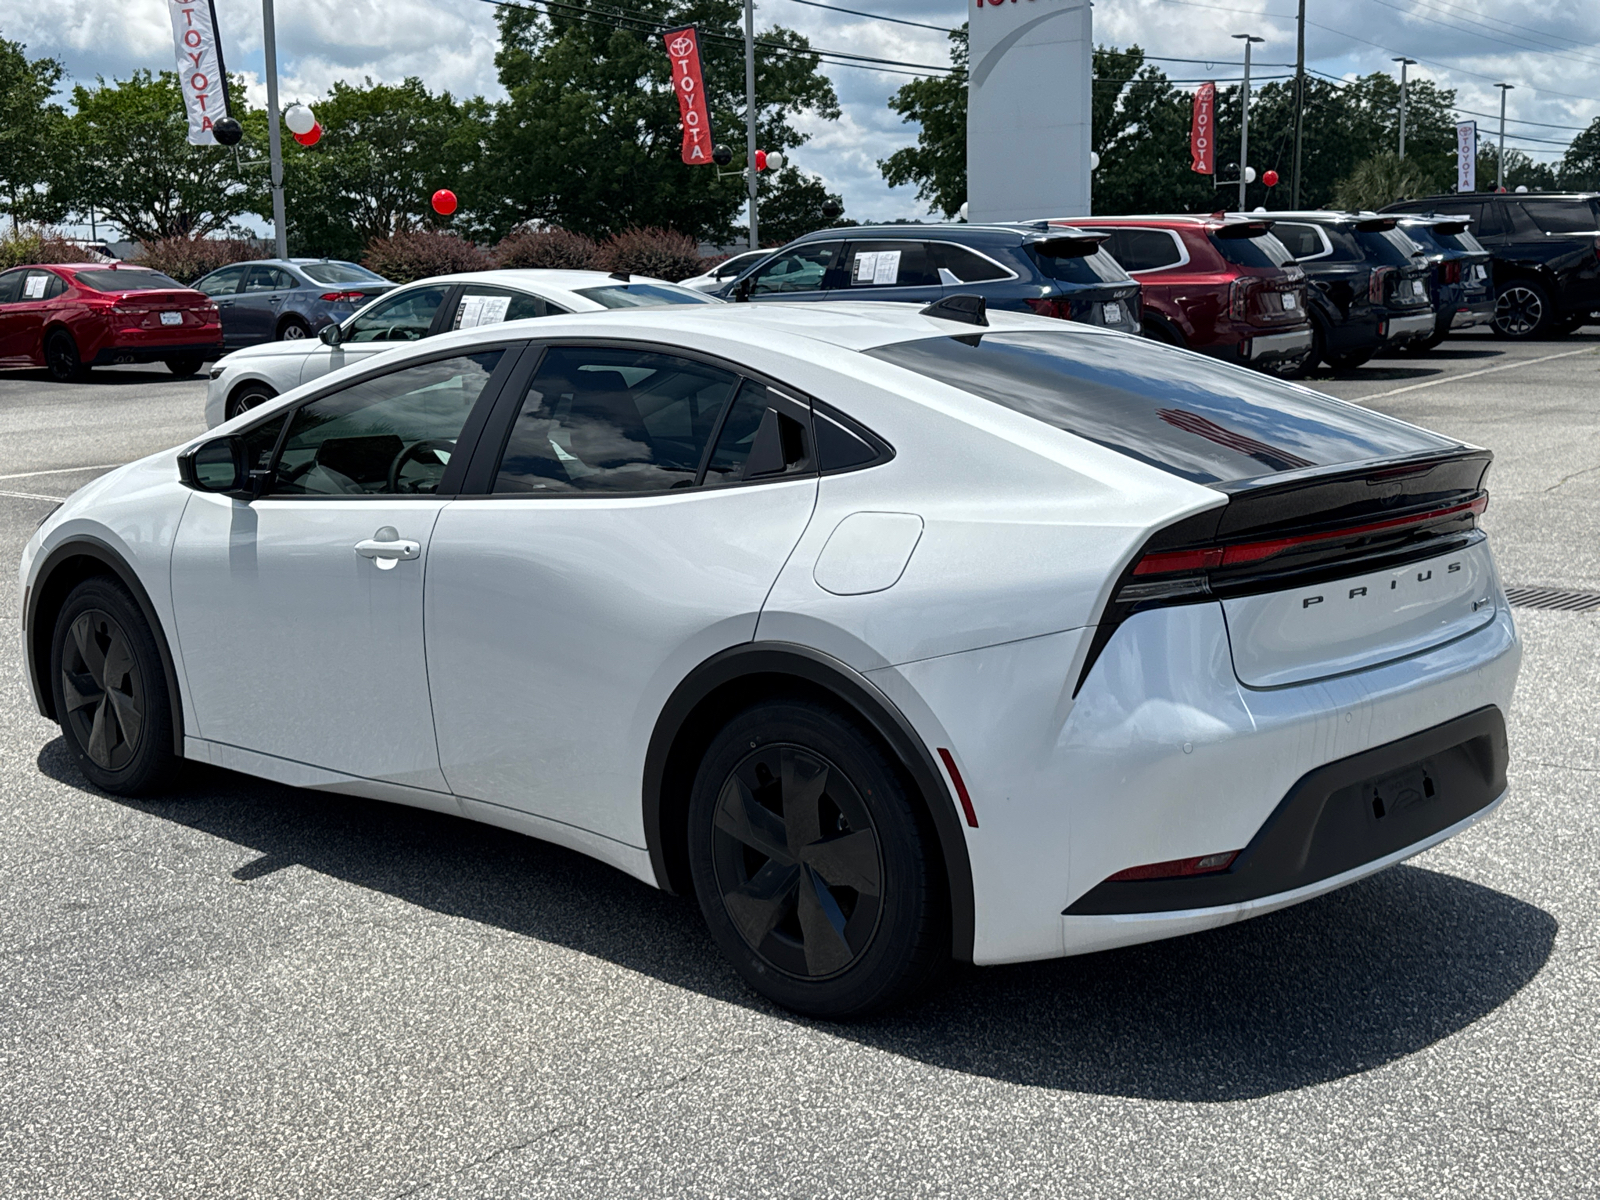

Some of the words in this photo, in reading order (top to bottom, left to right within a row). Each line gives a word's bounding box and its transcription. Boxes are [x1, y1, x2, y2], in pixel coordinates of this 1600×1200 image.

[182, 8, 213, 133] TOYOTA
[678, 59, 705, 160] TOYOTA
[1196, 102, 1208, 171] TOYOTA
[1461, 136, 1470, 188] TOYOTA
[1302, 561, 1461, 609] PRIUS
